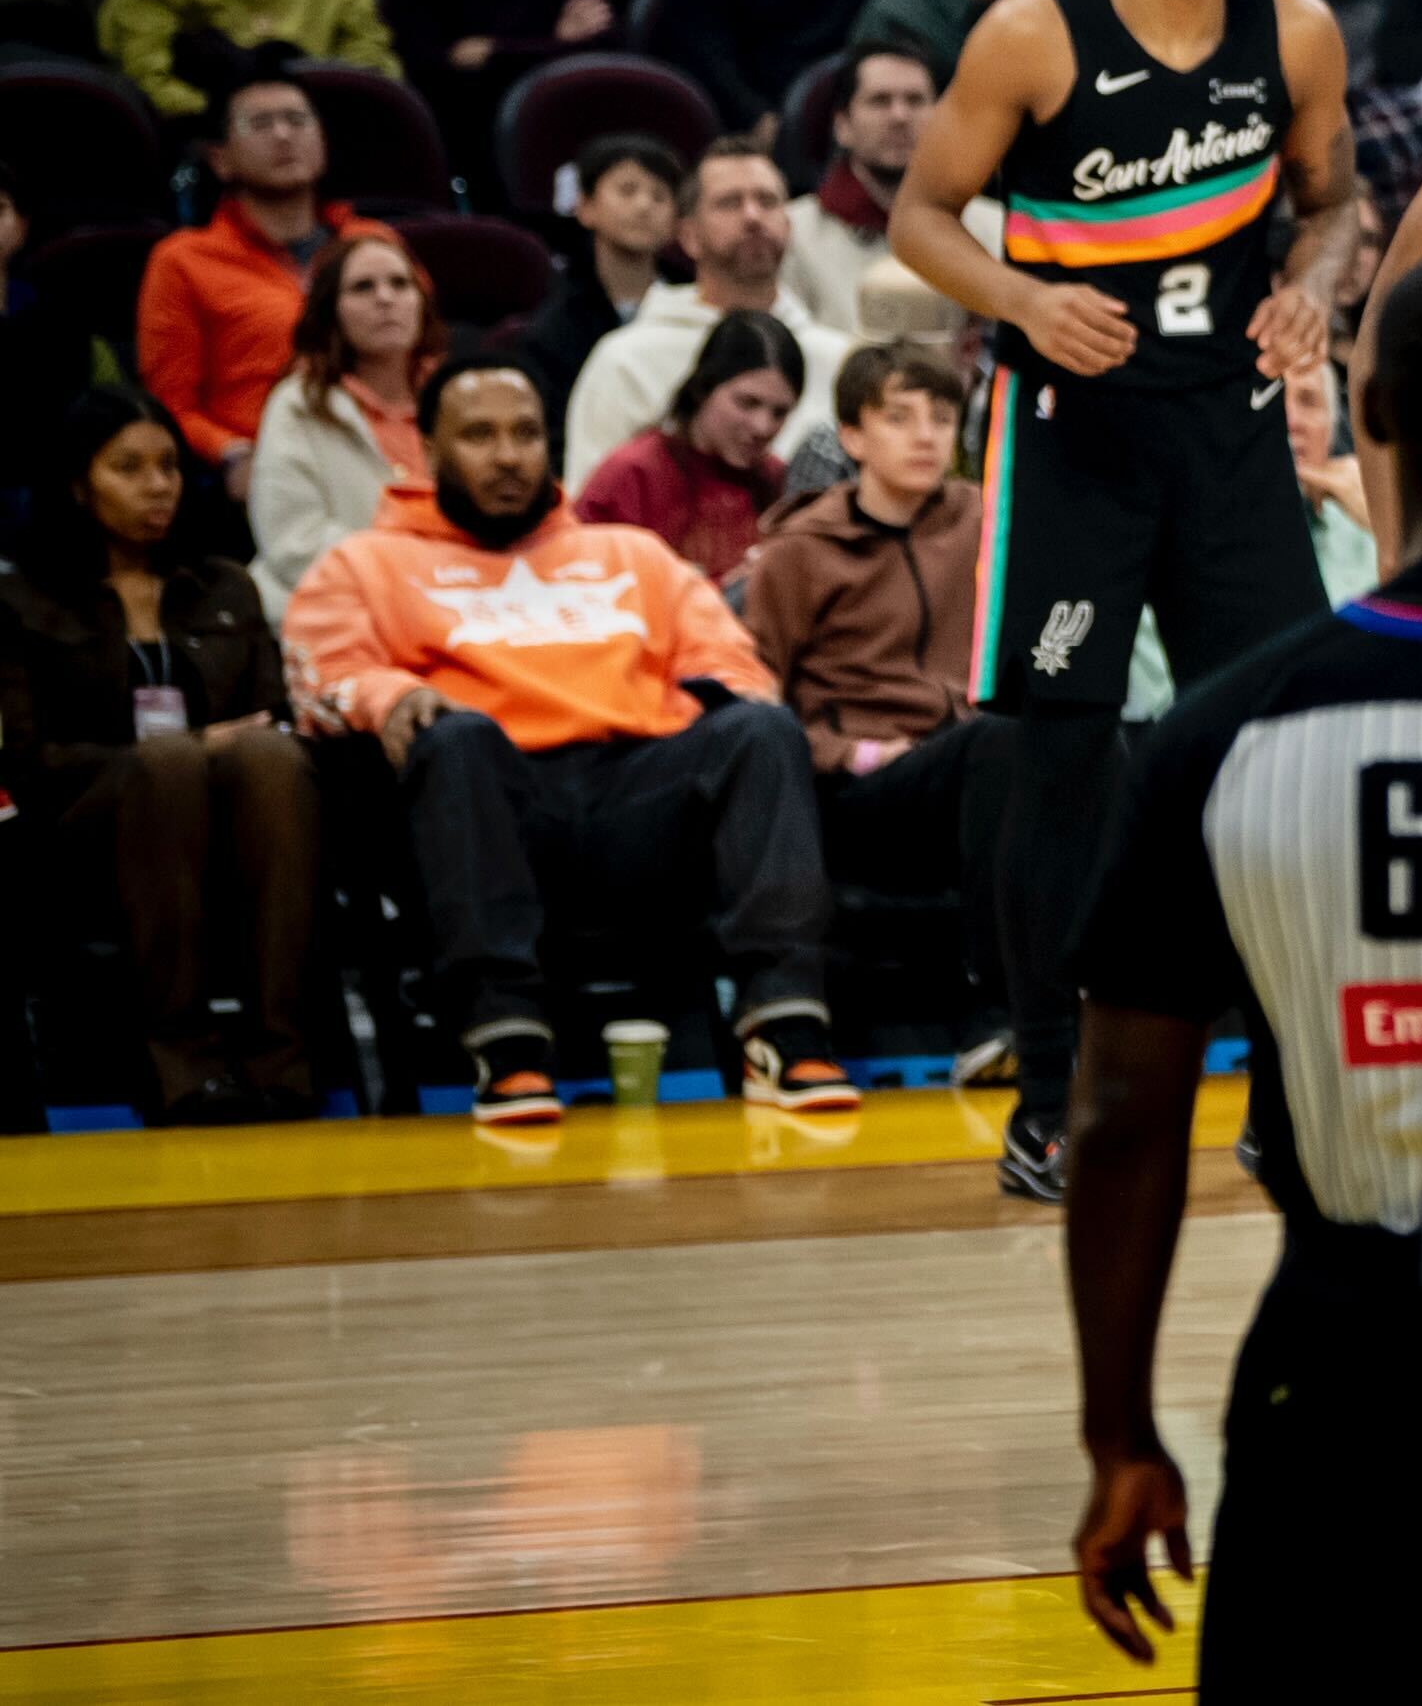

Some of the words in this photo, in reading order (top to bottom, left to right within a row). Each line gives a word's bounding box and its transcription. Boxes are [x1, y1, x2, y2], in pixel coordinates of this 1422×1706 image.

[1072, 147, 1149, 202] San
[1149, 114, 1273, 186] Antonio
[1155, 262, 1215, 337] 2
